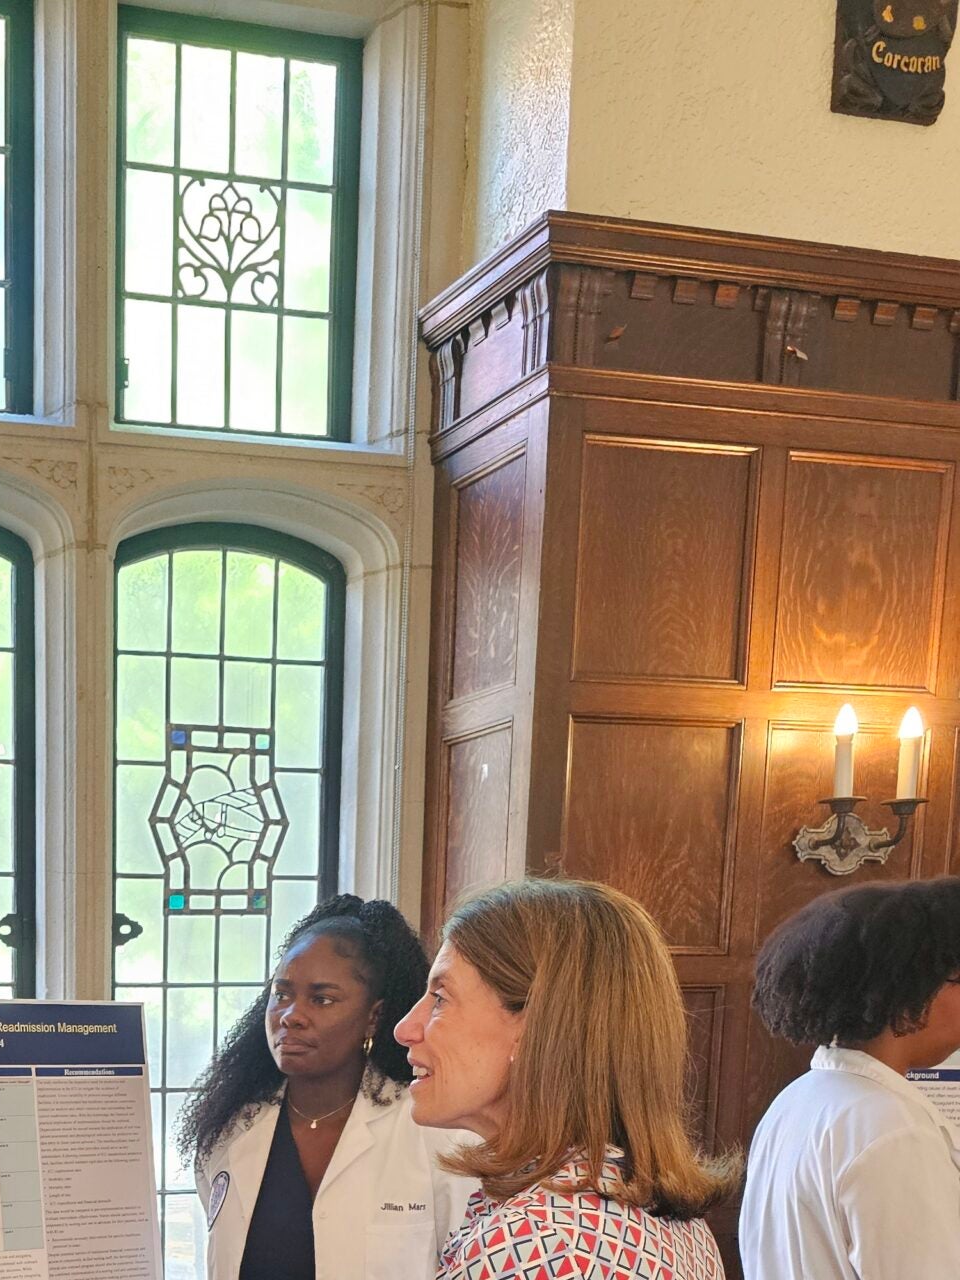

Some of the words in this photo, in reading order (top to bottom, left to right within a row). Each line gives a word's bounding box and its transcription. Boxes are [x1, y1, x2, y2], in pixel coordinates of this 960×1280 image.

[871, 41, 941, 73] Corcoran
[57, 1022, 118, 1036] Management
[905, 1070, 941, 1080] ckground
